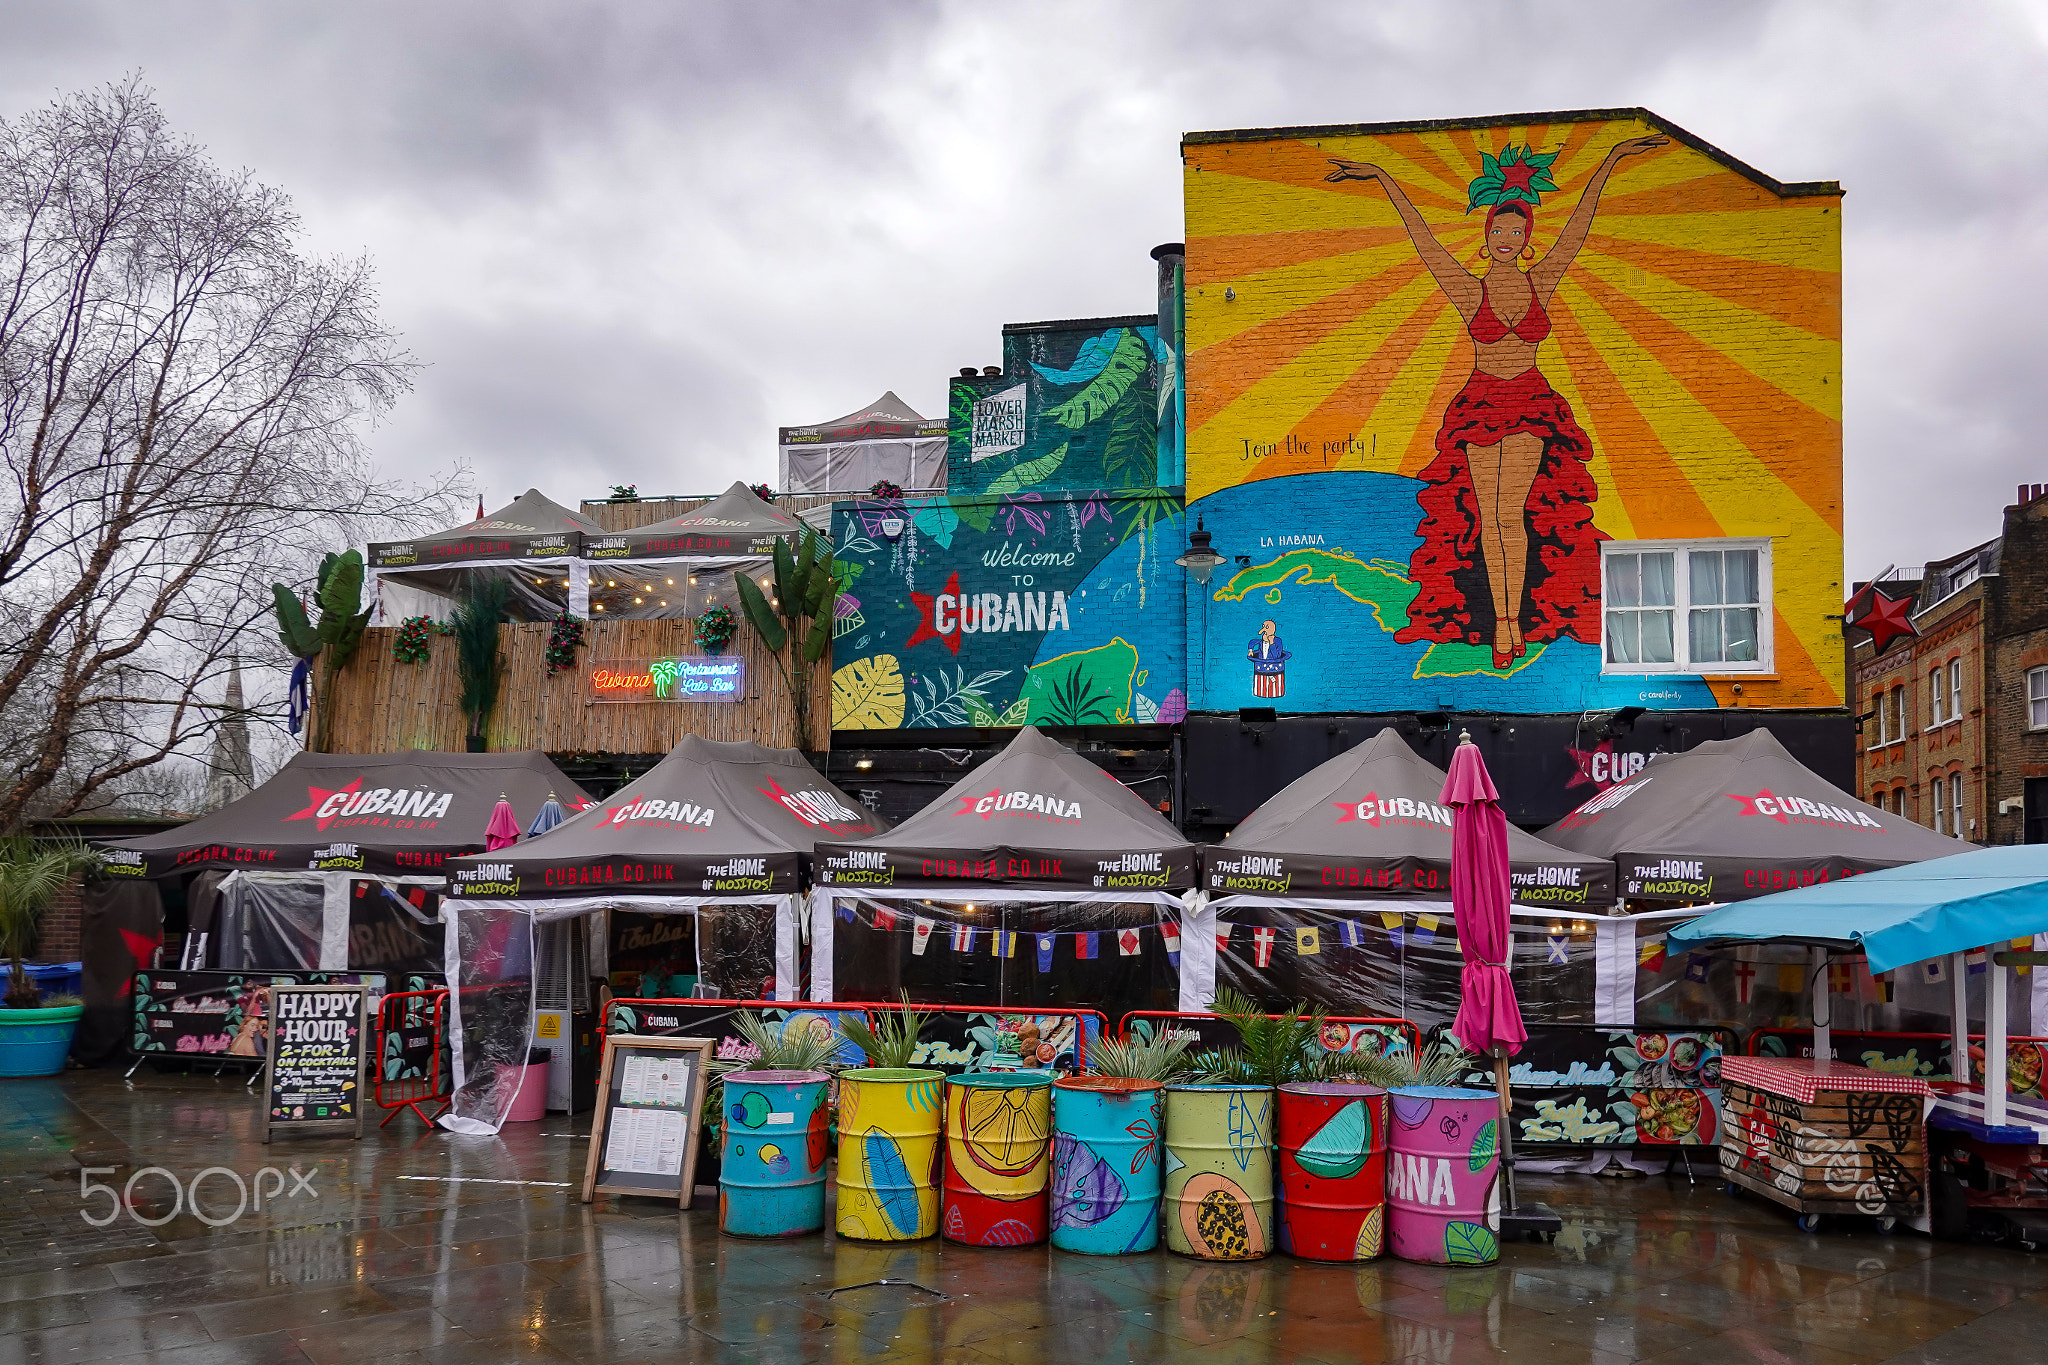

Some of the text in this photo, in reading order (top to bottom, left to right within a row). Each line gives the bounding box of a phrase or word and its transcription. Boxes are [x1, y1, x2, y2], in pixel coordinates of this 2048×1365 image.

[978, 400, 1022, 416] LOWER
[834, 425, 902, 437] CUBANA.CO.UK
[929, 421, 948, 429] HOME
[977, 415, 1023, 431] MARSH
[800, 428, 818, 436] HOME
[975, 430, 1024, 448] MARKET
[1239, 438, 1279, 461] Join
[1287, 435, 1311, 455] the
[471, 521, 536, 532] CUBANA
[681, 517, 750, 528] CUBANA
[543, 536, 565, 547] HOME
[603, 538, 627, 549] HOME
[647, 538, 731, 551] CUBANA.CO.UK
[766, 535, 789, 545] HOE
[1260, 534, 1325, 547] LA HABANA
[391, 545, 414, 556] HOME
[432, 542, 511, 556] CUBANA.CO.UK
[982, 541, 1075, 567] Welcome
[1012, 575, 1034, 587] TO
[935, 590, 1070, 634] CUBANA
[679, 661, 738, 678] Restaurant
[593, 670, 650, 689] Cubana
[681, 678, 735, 695] Late Bar
[1592, 752, 1657, 783] CUB
[316, 788, 453, 819] CUBANA
[976, 792, 1083, 820] CUBANA
[612, 800, 715, 827] CUBANA
[996, 812, 1081, 826] CUBANA.CO.UK
[1755, 797, 1882, 828] CUBANA
[333, 817, 439, 830] CUBANA.CO.UK
[626, 821, 708, 834] CUBANA.CO.UK
[1793, 816, 1888, 835] CUBANA.CO.UK
[116, 850, 142, 865] HOME
[177, 847, 277, 864] CUBANA.CO.UK
[314, 843, 359, 858] THE HOME
[309, 856, 364, 870] OF MOJITOS!
[707, 859, 766, 876] THE HOME
[827, 852, 887, 869] THE HOME
[922, 858, 1063, 878] CUBANA.CO.UK
[1098, 853, 1163, 872] THE HOME
[1216, 856, 1284, 877] THE HOME
[457, 864, 514, 881] THE HOME
[545, 865, 675, 886] CUBANA.CO.UK
[823, 866, 894, 885] OF MOJITOS!
[1093, 866, 1170, 887] OF MOJITOS!
[1511, 867, 1581, 886] THE HOME
[1634, 860, 1704, 880] THE HOME
[453, 877, 520, 896] OF MOJITOS!
[702, 871, 774, 892] OF MOJITOS!
[1211, 873, 1292, 894] OF MOJITOS!
[1629, 876, 1713, 898] OF MOJITOS!
[1521, 882, 1589, 903] MOJITOS!
[278, 993, 360, 1018] HAPPY
[647, 1016, 679, 1027] CUBANA
[283, 1020, 350, 1044] HOUR
[280, 1044, 351, 1057] 2-FOR-1
[930, 1041, 977, 1064] Food
[276, 1056, 357, 1067] ON COCKTAILS
[1535, 1097, 1587, 1122] Fresh
[1520, 1119, 1620, 1143] Free Range
